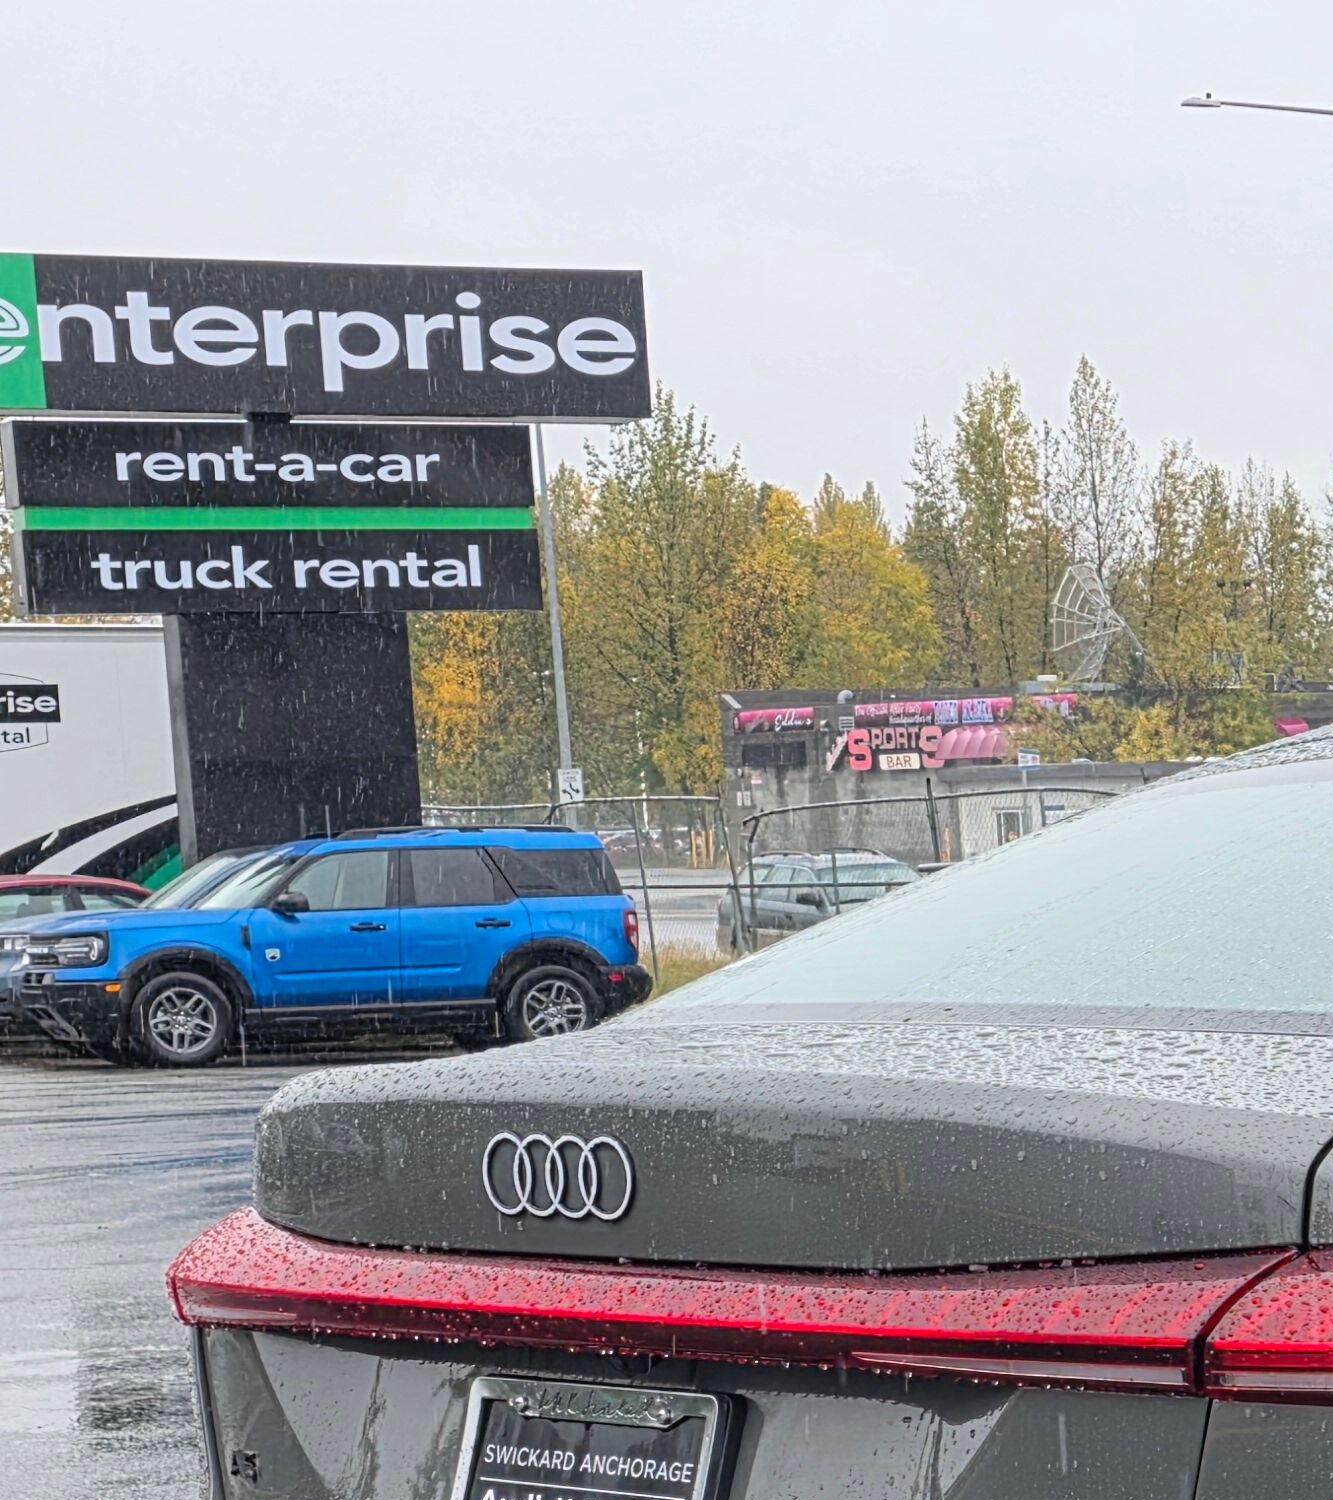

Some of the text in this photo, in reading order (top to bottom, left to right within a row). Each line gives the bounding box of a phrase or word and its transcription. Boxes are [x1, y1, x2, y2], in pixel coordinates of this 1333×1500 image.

[115, 445, 440, 482] rent-a-car
[91, 544, 481, 591] truck rental
[848, 725, 945, 771] SPORTS
[886, 755, 912, 768] BAR
[484, 1444, 694, 1483] SWICKARD ANCHORAGE
